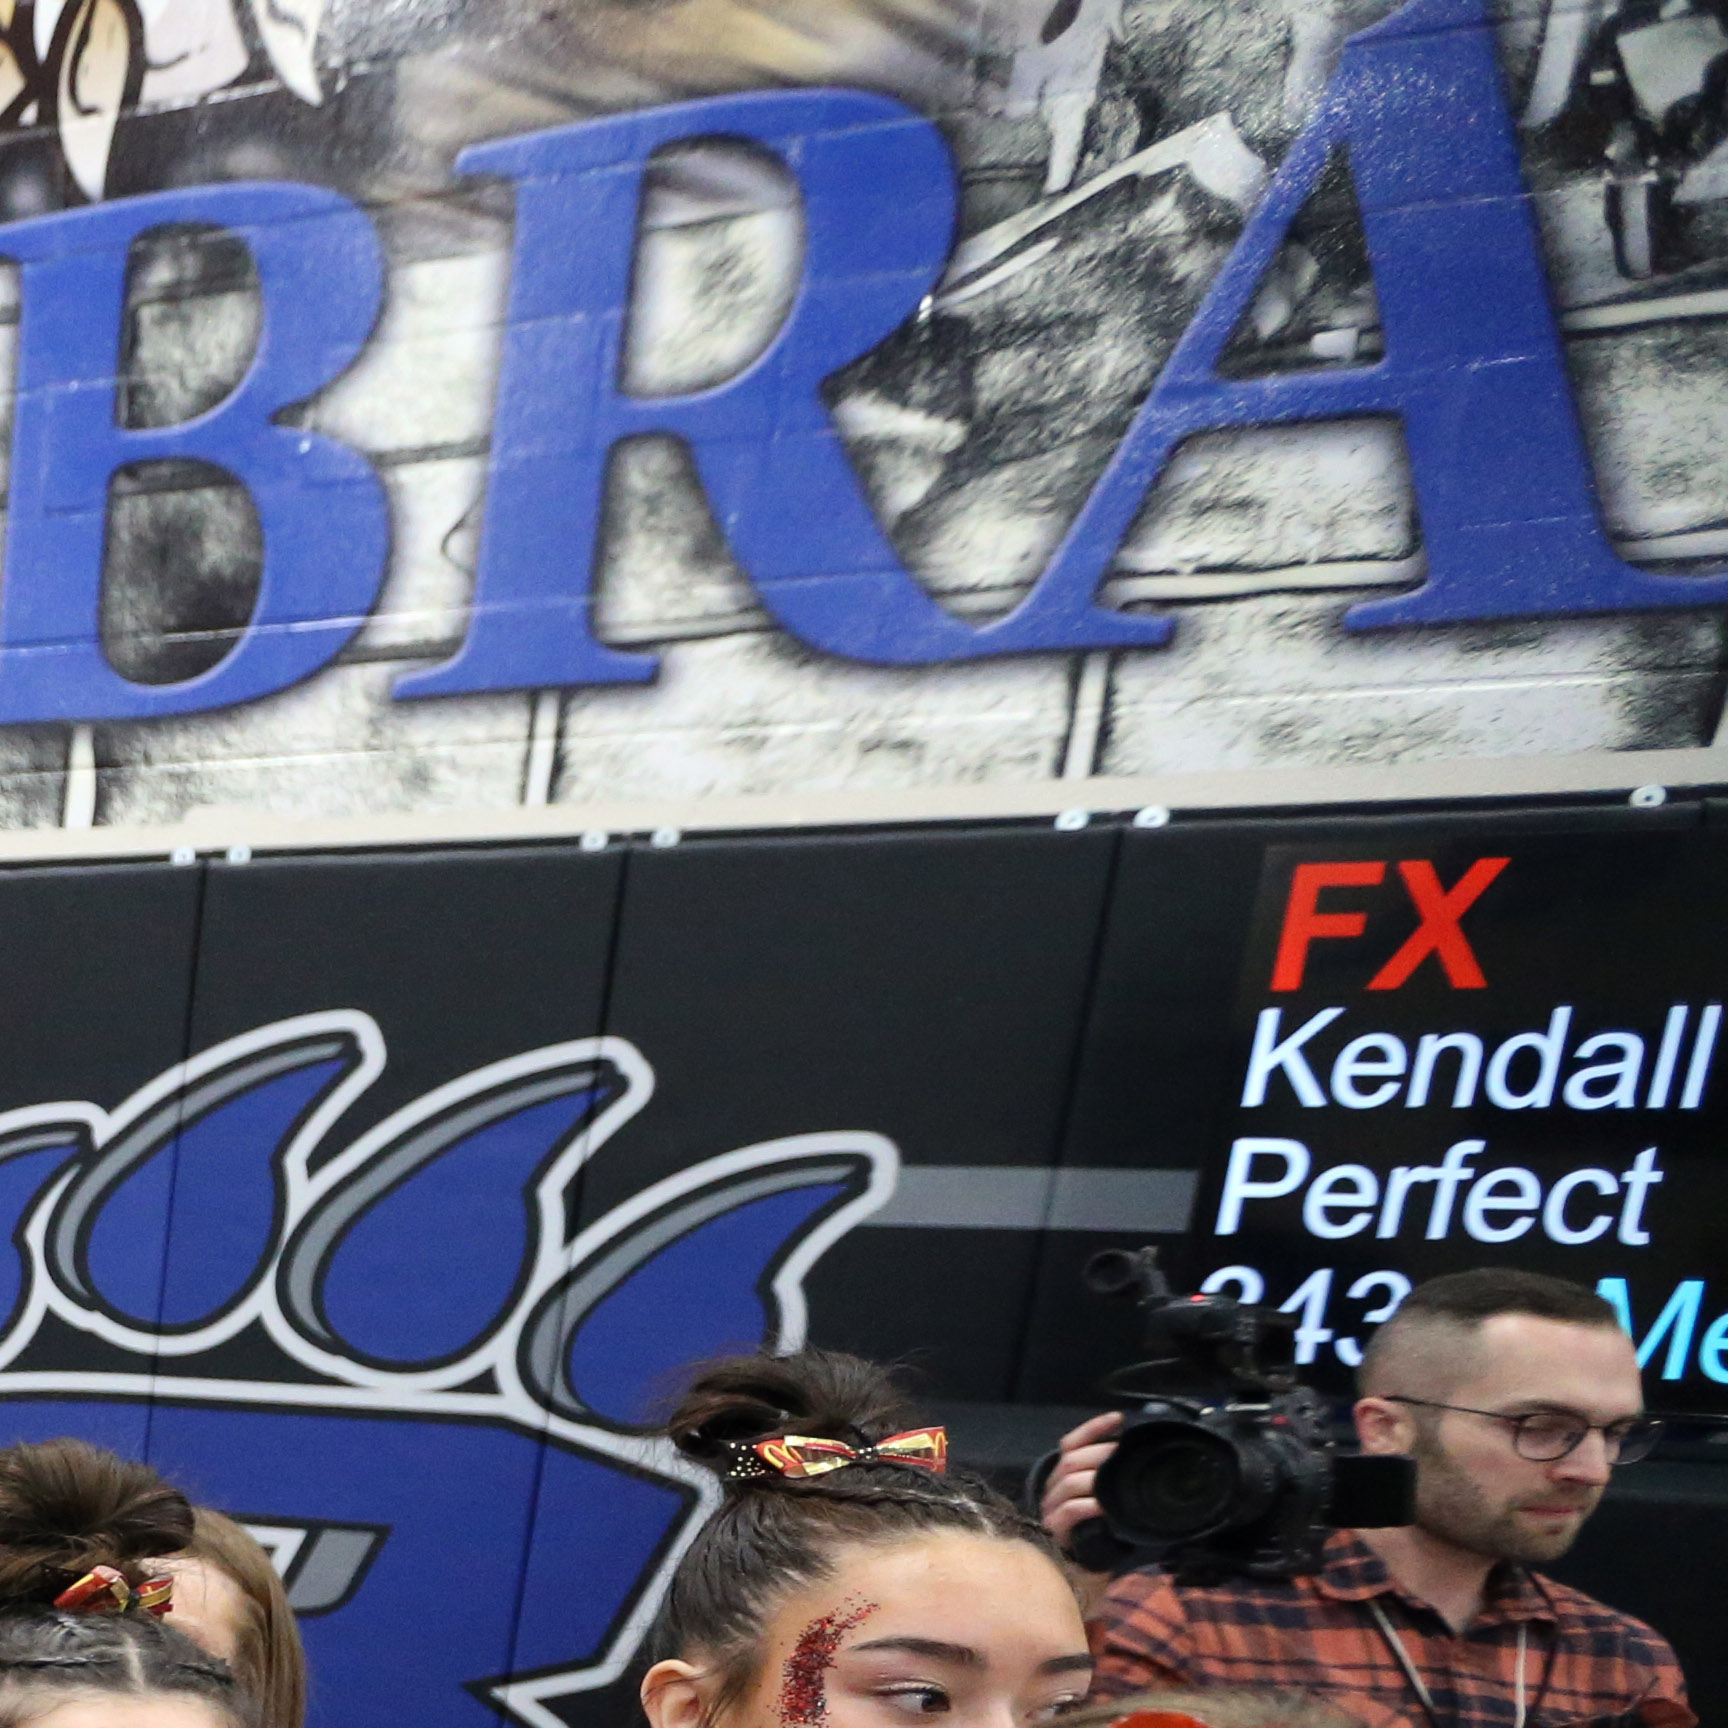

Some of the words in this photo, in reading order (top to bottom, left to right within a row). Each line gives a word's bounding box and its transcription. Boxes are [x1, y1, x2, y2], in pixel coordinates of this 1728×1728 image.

[1269, 856, 1512, 992] FX
[1240, 1005, 1723, 1111] Kendall
[1214, 1137, 1664, 1245] Perfect
